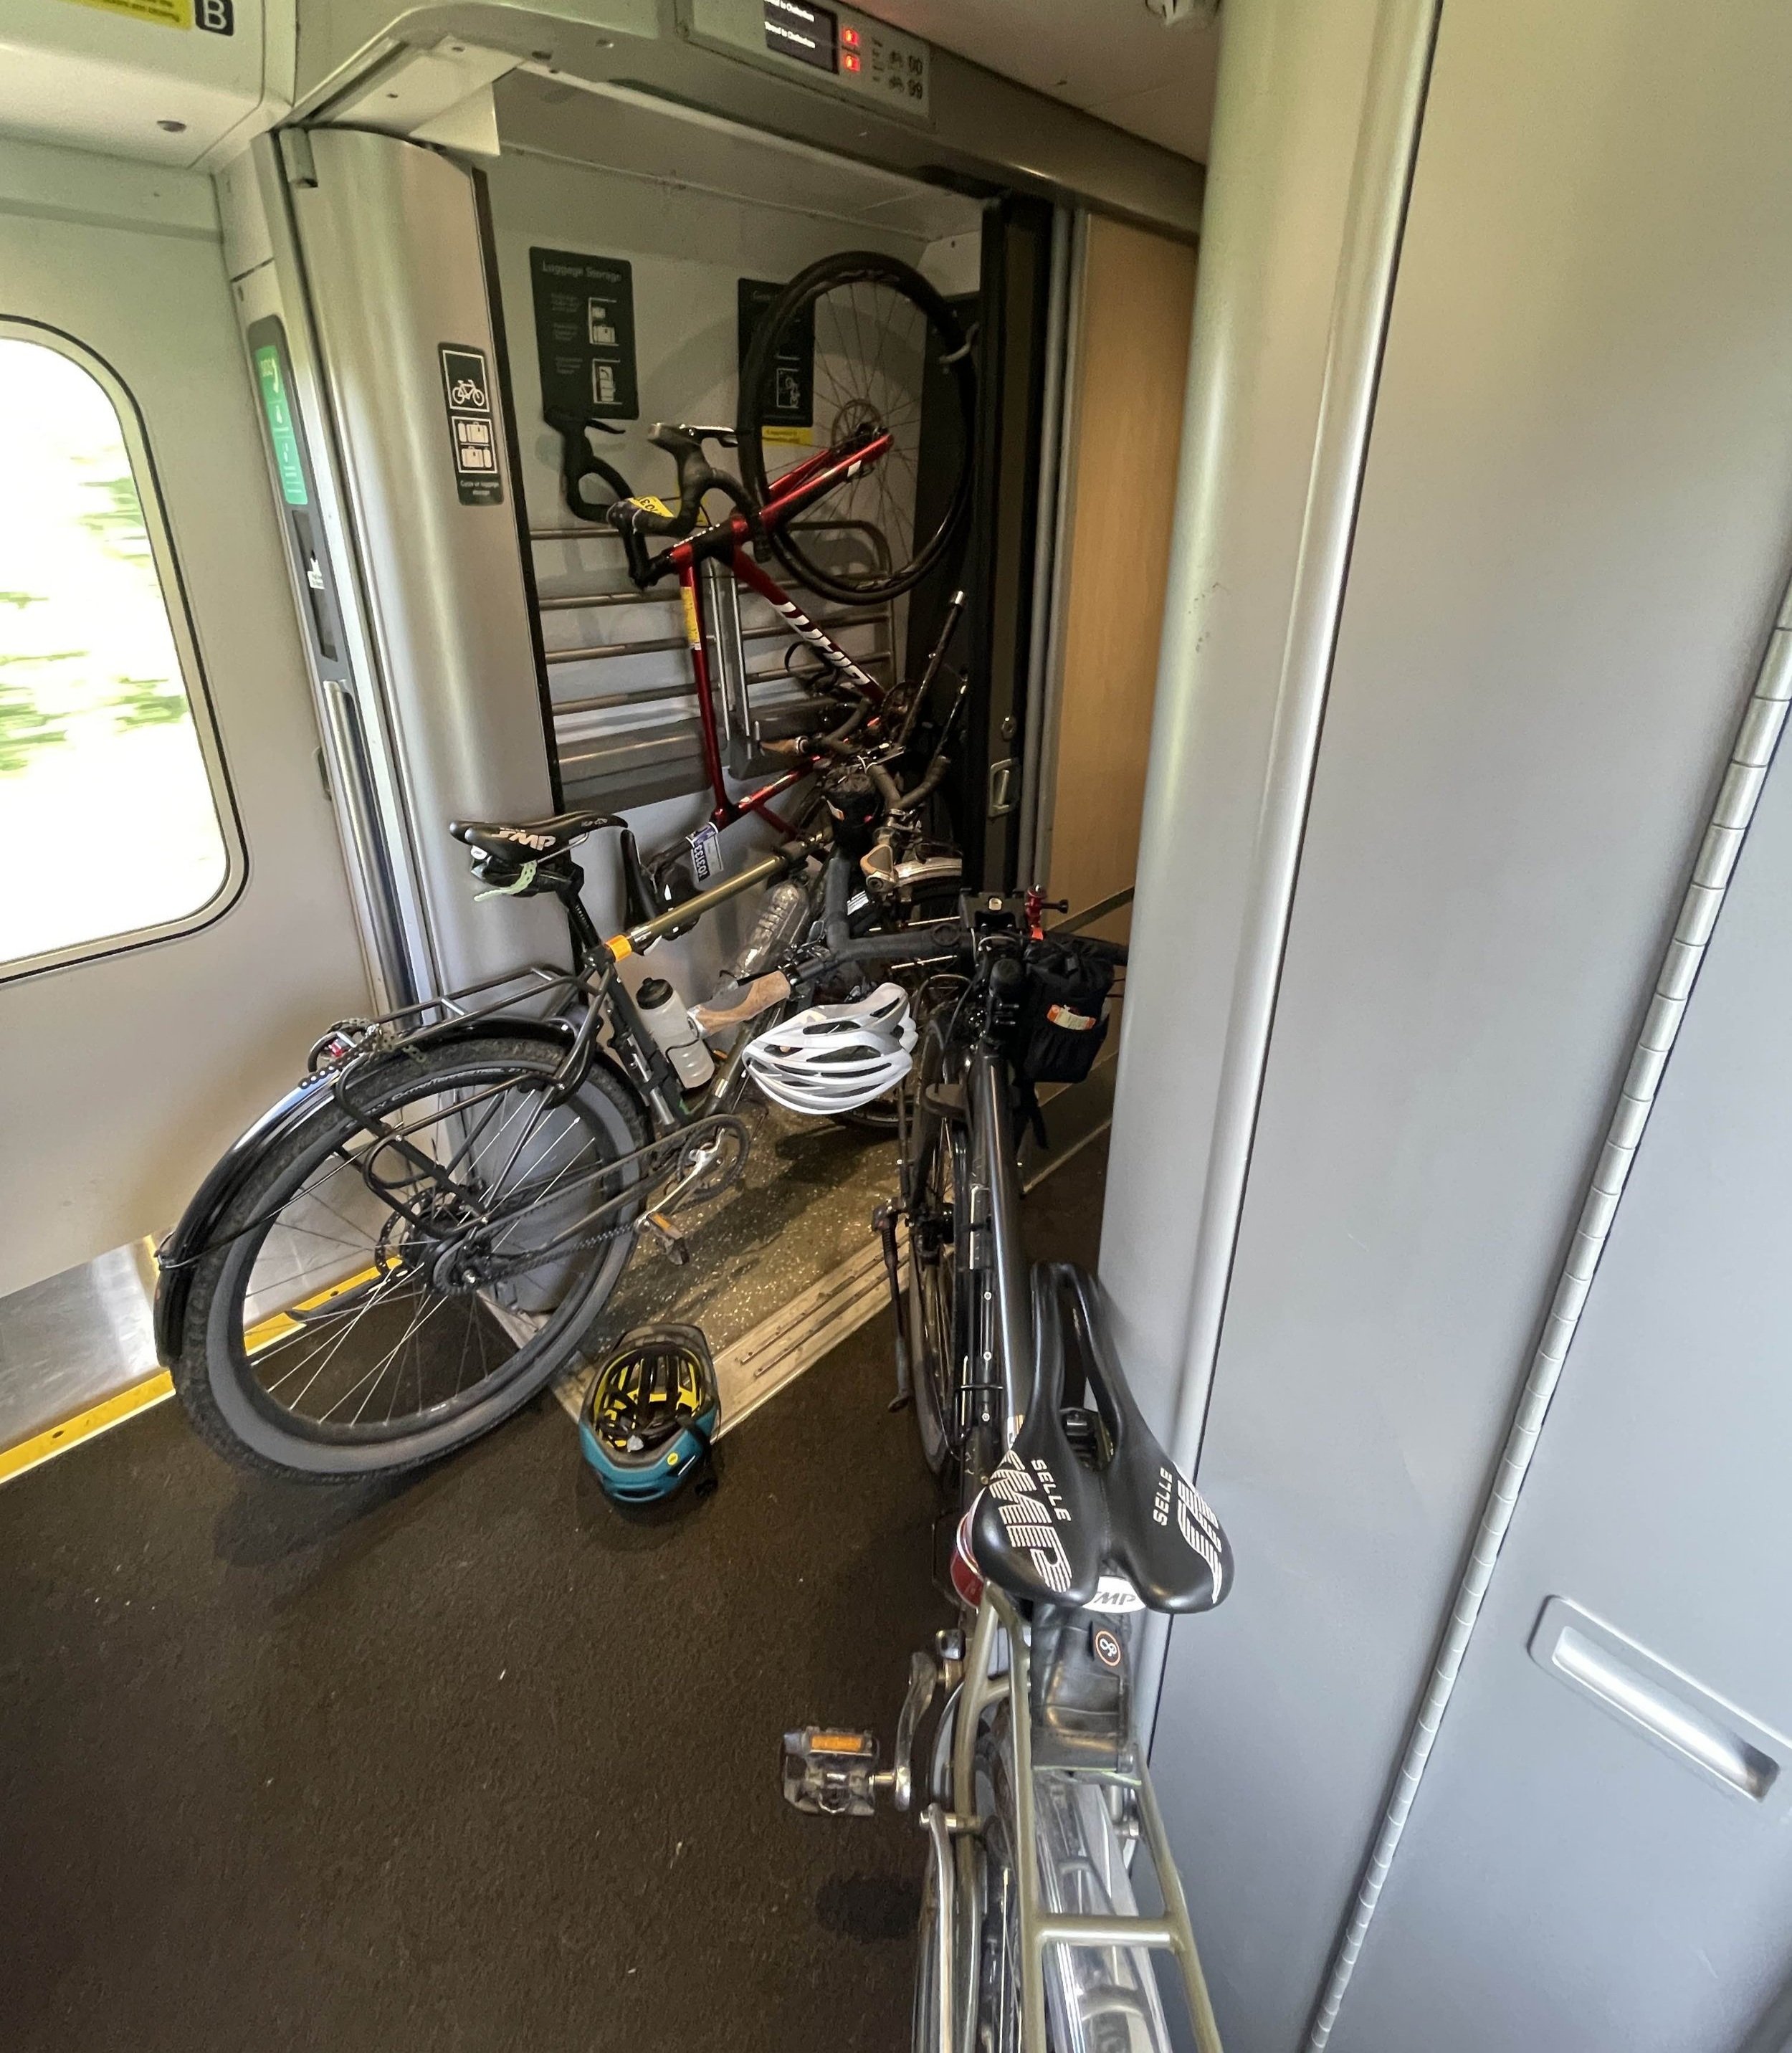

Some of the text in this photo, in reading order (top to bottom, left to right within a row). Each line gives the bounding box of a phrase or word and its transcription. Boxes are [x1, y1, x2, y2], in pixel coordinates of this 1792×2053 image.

[203, 0, 227, 29] B
[1030, 1459, 1072, 1522] SELLE
[1153, 1467, 1173, 1526] SELLE
[1094, 1591, 1136, 1606] MP
